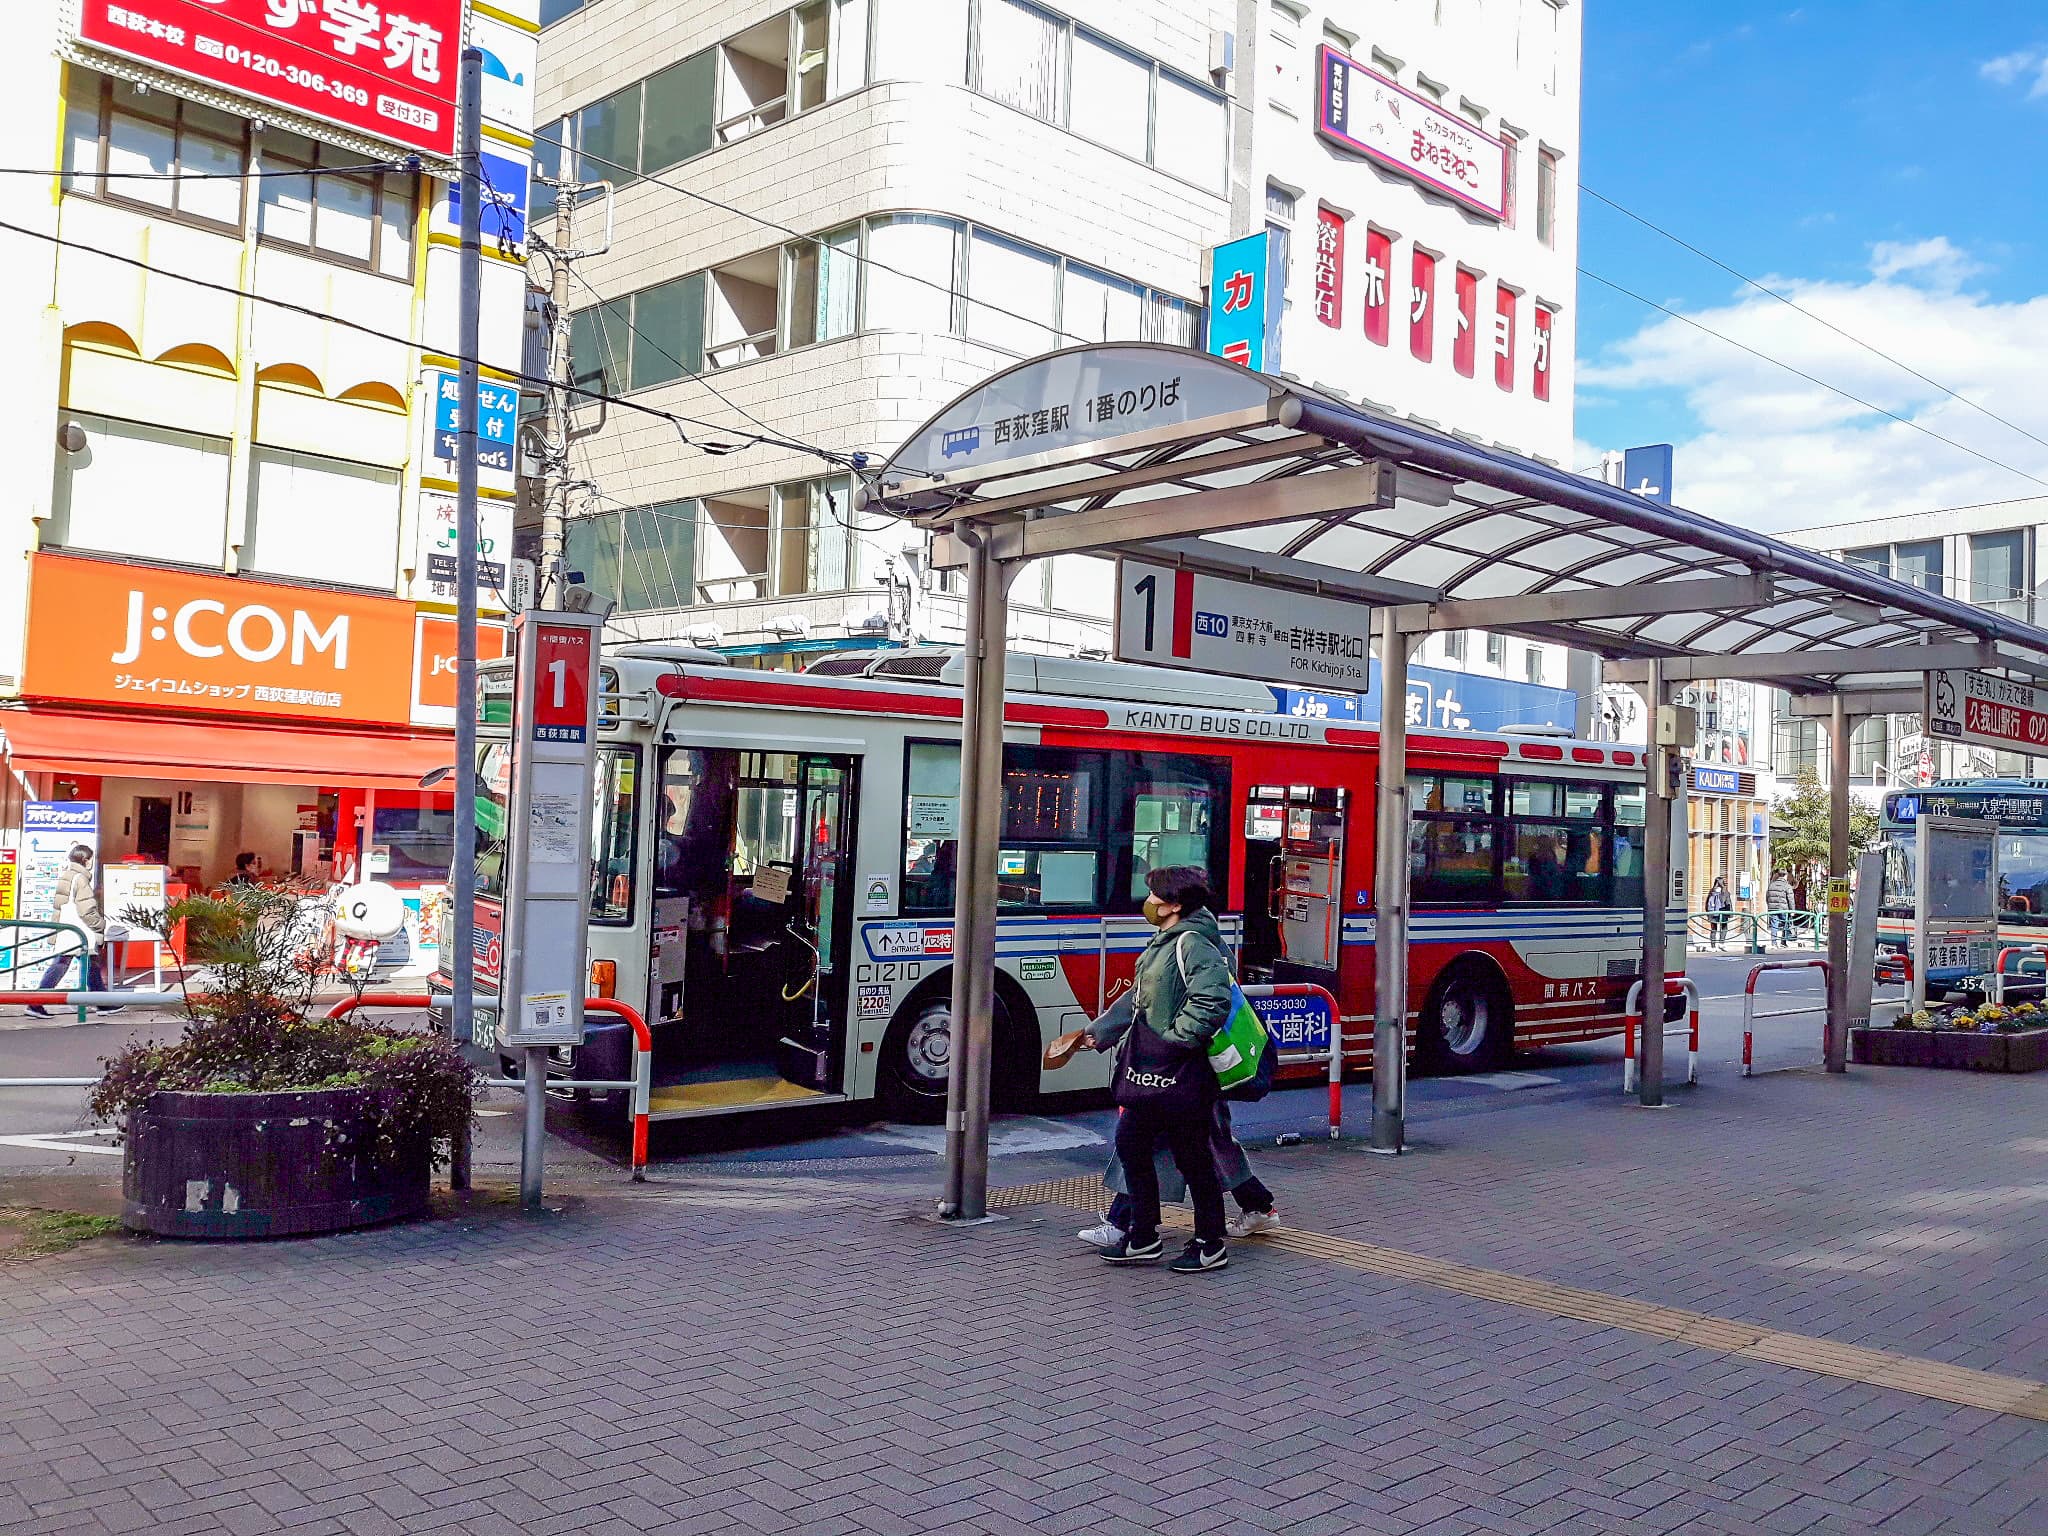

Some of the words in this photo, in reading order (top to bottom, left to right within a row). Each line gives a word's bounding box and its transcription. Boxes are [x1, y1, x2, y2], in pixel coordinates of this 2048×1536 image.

[108, 4, 185, 46] 西荻本校
[224, 45, 369, 107] 0120-306-369
[382, 99, 433, 127] 受付3F
[1410, 129, 1478, 188] まねきねこ
[1315, 219, 1337, 320] 溶岩石
[1364, 256, 1550, 372] ホットヨガ
[994, 404, 1070, 446] 西荻窪駅
[1085, 376, 1181, 423] 1番のりば
[1134, 574, 1156, 651] 1
[1197, 615, 1226, 634] 西10
[1290, 626, 1363, 660] 吉祥寺駅北口
[1231, 616, 1274, 633] 東京女子大前
[111, 590, 349, 670] J:COM
[1290, 658, 1308, 673] FOR
[1311, 660, 1345, 679] Kichijoji
[114, 674, 251, 699] ジェイコムショップ
[254, 685, 342, 708] 西荻窪駅前店
[548, 659, 566, 708] 1
[1126, 709, 1193, 731] KANTO
[1200, 716, 1241, 734] BUS
[1970, 701, 2020, 738] 久我山駅行
[536, 727, 580, 740] 西荻窪駅
[1699, 772, 1722, 788] KALDI
[1932, 803, 1950, 817] 03
[891, 944, 921, 954] ENTRANCE
[895, 931, 918, 944] 入口
[924, 933, 952, 949] バス特
[1928, 946, 1967, 968] 荻窪病院
[856, 962, 921, 983] C1210
[1544, 981, 1596, 998] 関東バス
[863, 996, 884, 1009] 220
